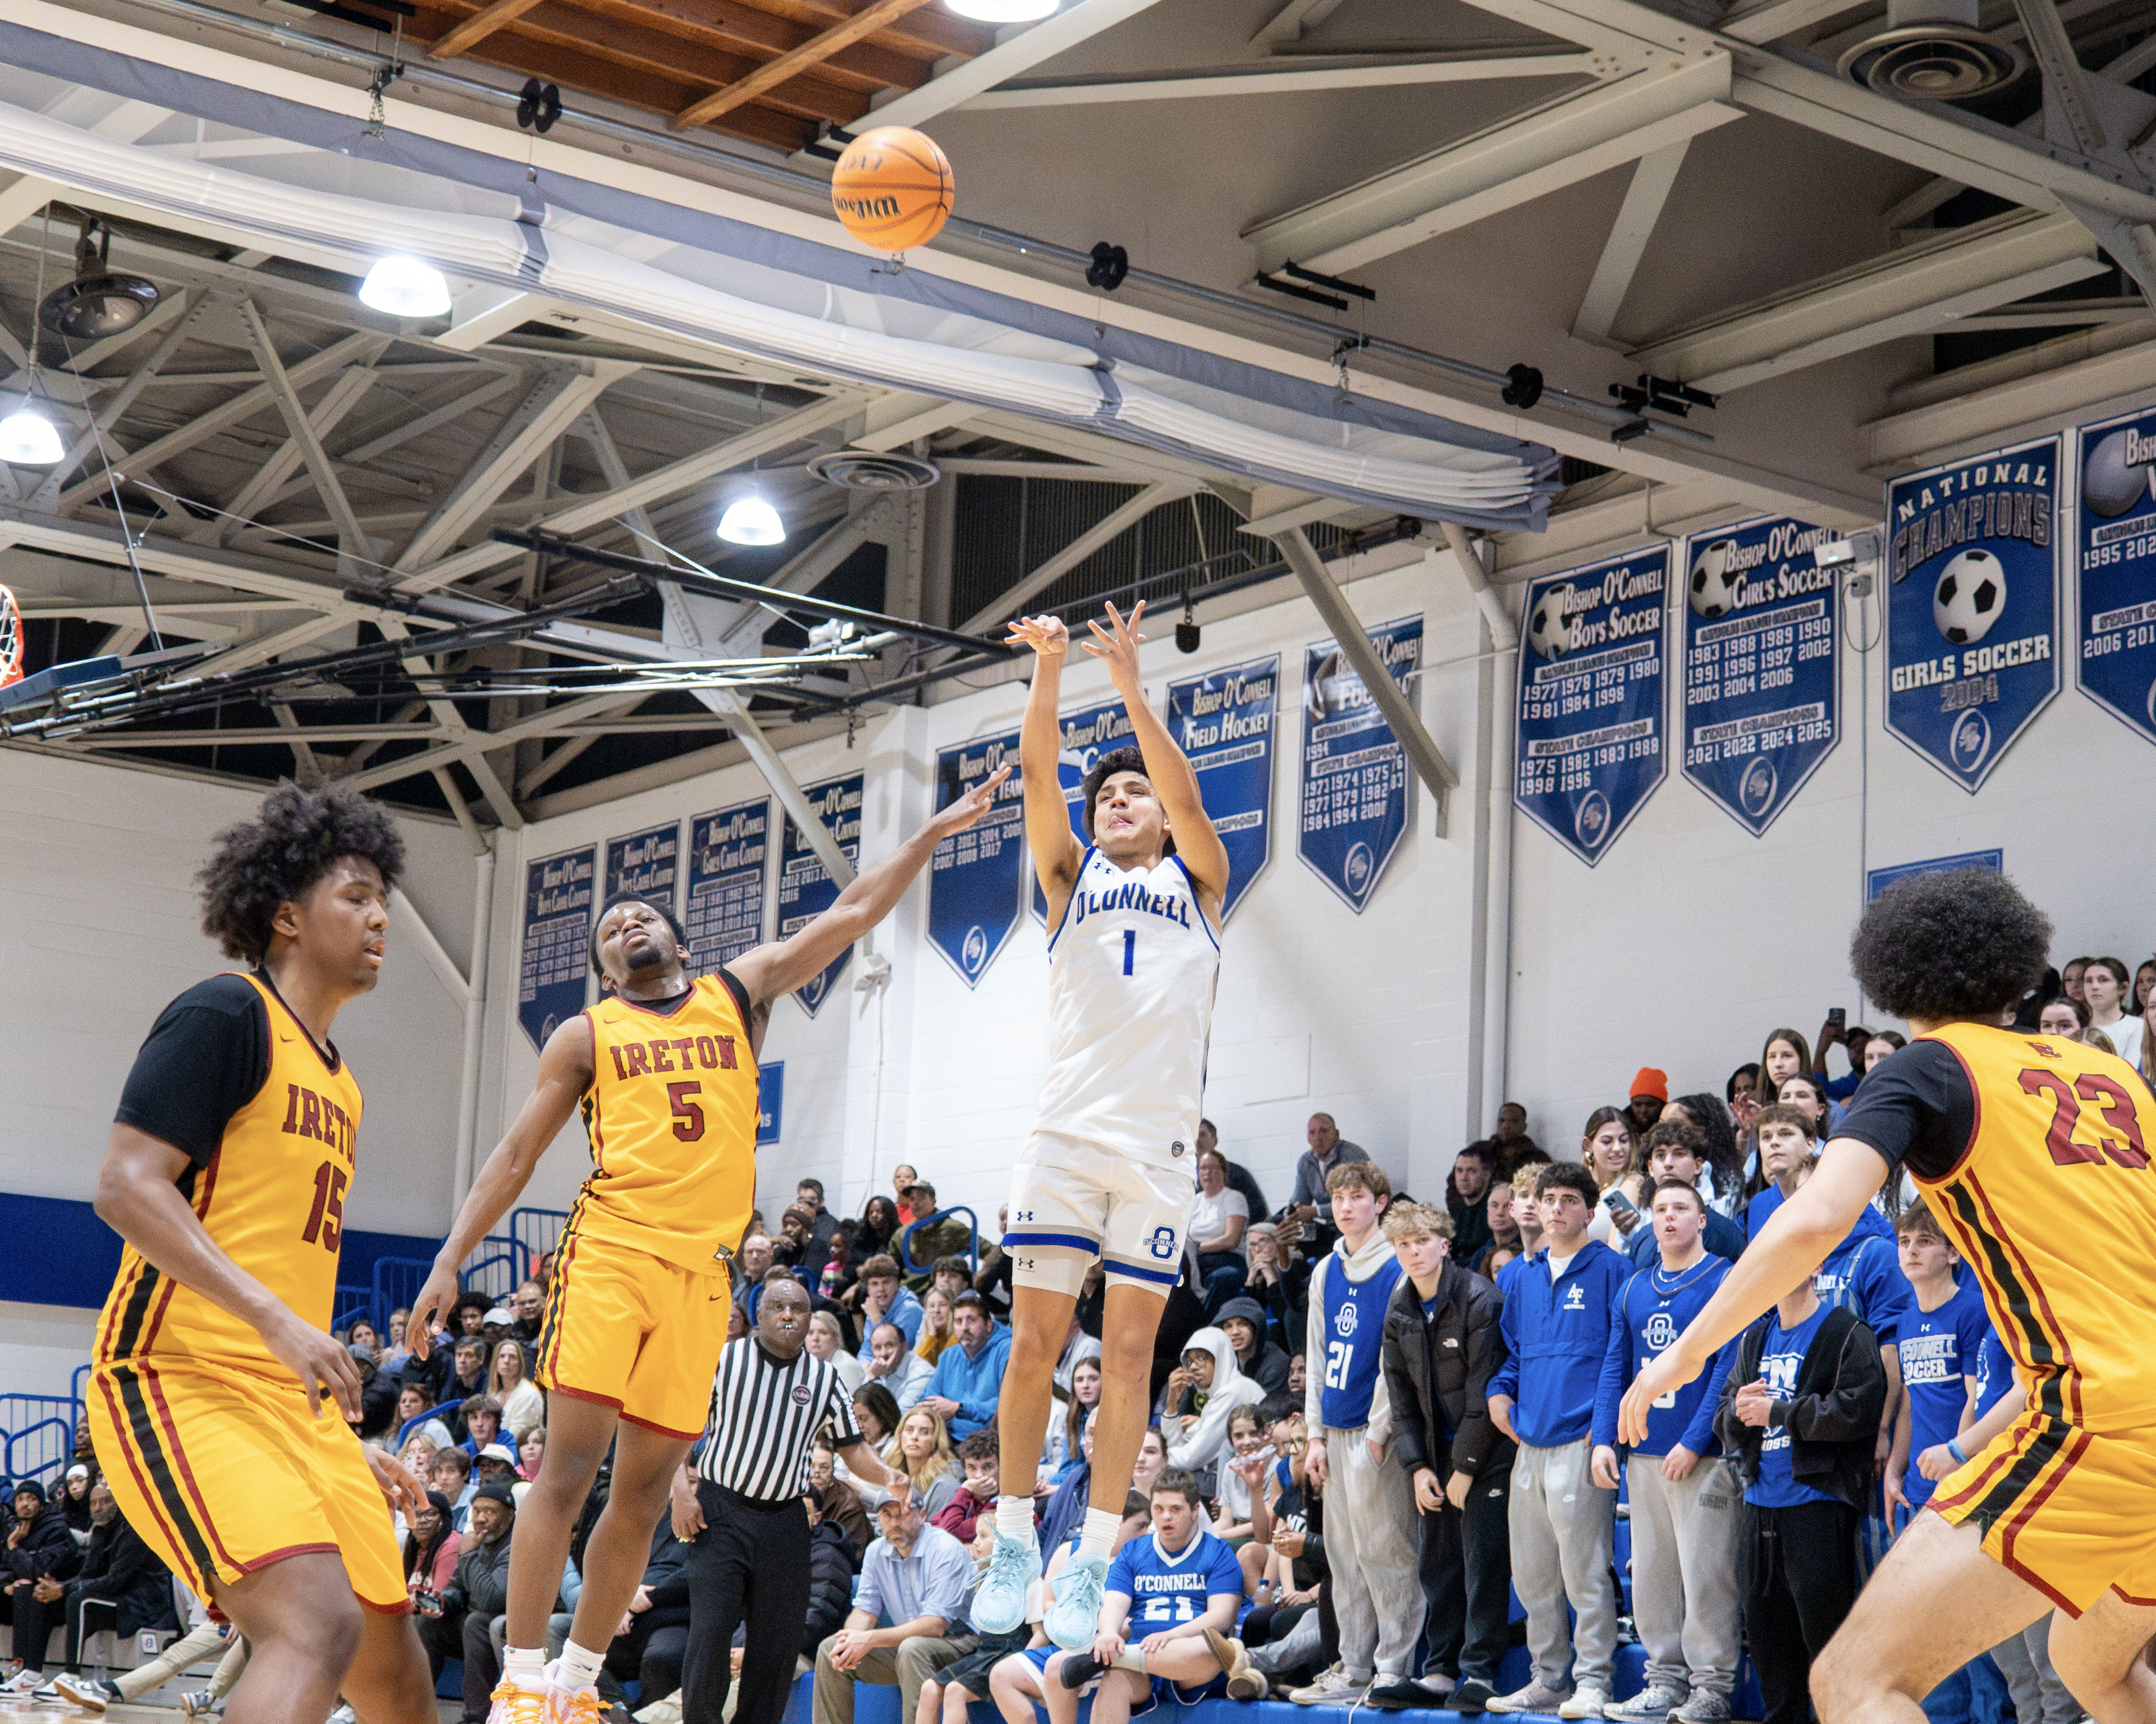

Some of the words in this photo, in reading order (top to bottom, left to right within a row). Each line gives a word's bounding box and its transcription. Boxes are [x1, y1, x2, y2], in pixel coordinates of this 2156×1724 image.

[1898, 465, 2047, 523] NATIONAL
[1725, 539, 1766, 573] BISHOP
[1892, 493, 2050, 583] CHAMPIONS
[2084, 543, 2121, 570] 1995
[2126, 535, 2156, 561] 202
[1564, 583, 1601, 615] BISHOP
[1603, 568, 1663, 605] O'CONNELL
[1778, 563, 1832, 599] SOCCER
[1609, 607, 1660, 640] SOCCER
[1688, 644, 1719, 666] 1983
[1724, 635, 1756, 658] 1988
[1761, 626, 1793, 650] 1989
[1798, 617, 1831, 641] 1990
[1688, 663, 1719, 686] 1991
[1761, 646, 1793, 670] 1997
[1798, 638, 1831, 662] 2002
[1892, 655, 1956, 693] GIRLS
[1963, 635, 2050, 677] SOCCER
[2084, 632, 2121, 658] 2006
[1223, 675, 1271, 709] O'CONNELL
[1524, 682, 1559, 701] 1977
[1562, 674, 1591, 696] 1978
[1595, 666, 1624, 689] 1979
[1629, 658, 1659, 680] 1980
[1688, 684, 1719, 705] 2003
[1724, 675, 1755, 698] 2004
[1760, 667, 1793, 690] 2006
[1941, 673, 1999, 713] 2004
[1523, 701, 1558, 720] 1981
[1562, 694, 1590, 715] 1984
[1595, 686, 1624, 708] 1998
[1185, 721, 1218, 750] FIELD
[1220, 712, 1269, 742] HOCKEY
[1687, 744, 1719, 766] 2021
[1723, 735, 1756, 758] 2022
[1761, 727, 1793, 751] 2024
[1797, 719, 1832, 743] 2025
[1331, 770, 1358, 791] 1974
[1362, 765, 1389, 785] 1975
[1520, 758, 1557, 778] 1975
[1562, 752, 1590, 774] 1982
[1594, 745, 1625, 767] 1983
[1304, 795, 1329, 815] 1977
[1331, 788, 1358, 809] 1979
[1520, 777, 1554, 796] 1998
[1123, 930, 1136, 976] 1
[610, 1035, 738, 1081] IRETON
[281, 1083, 355, 1170] IRETO
[667, 1081, 705, 1141] 5
[2017, 1069, 2152, 1170] 23
[301, 1160, 347, 1254] 15
[1325, 1341, 1354, 1390] 21
[1903, 1359, 1948, 1382] SOCCER
[1134, 1573, 1206, 1592] O'CONNELL
[1144, 1597, 1193, 1621] 21
